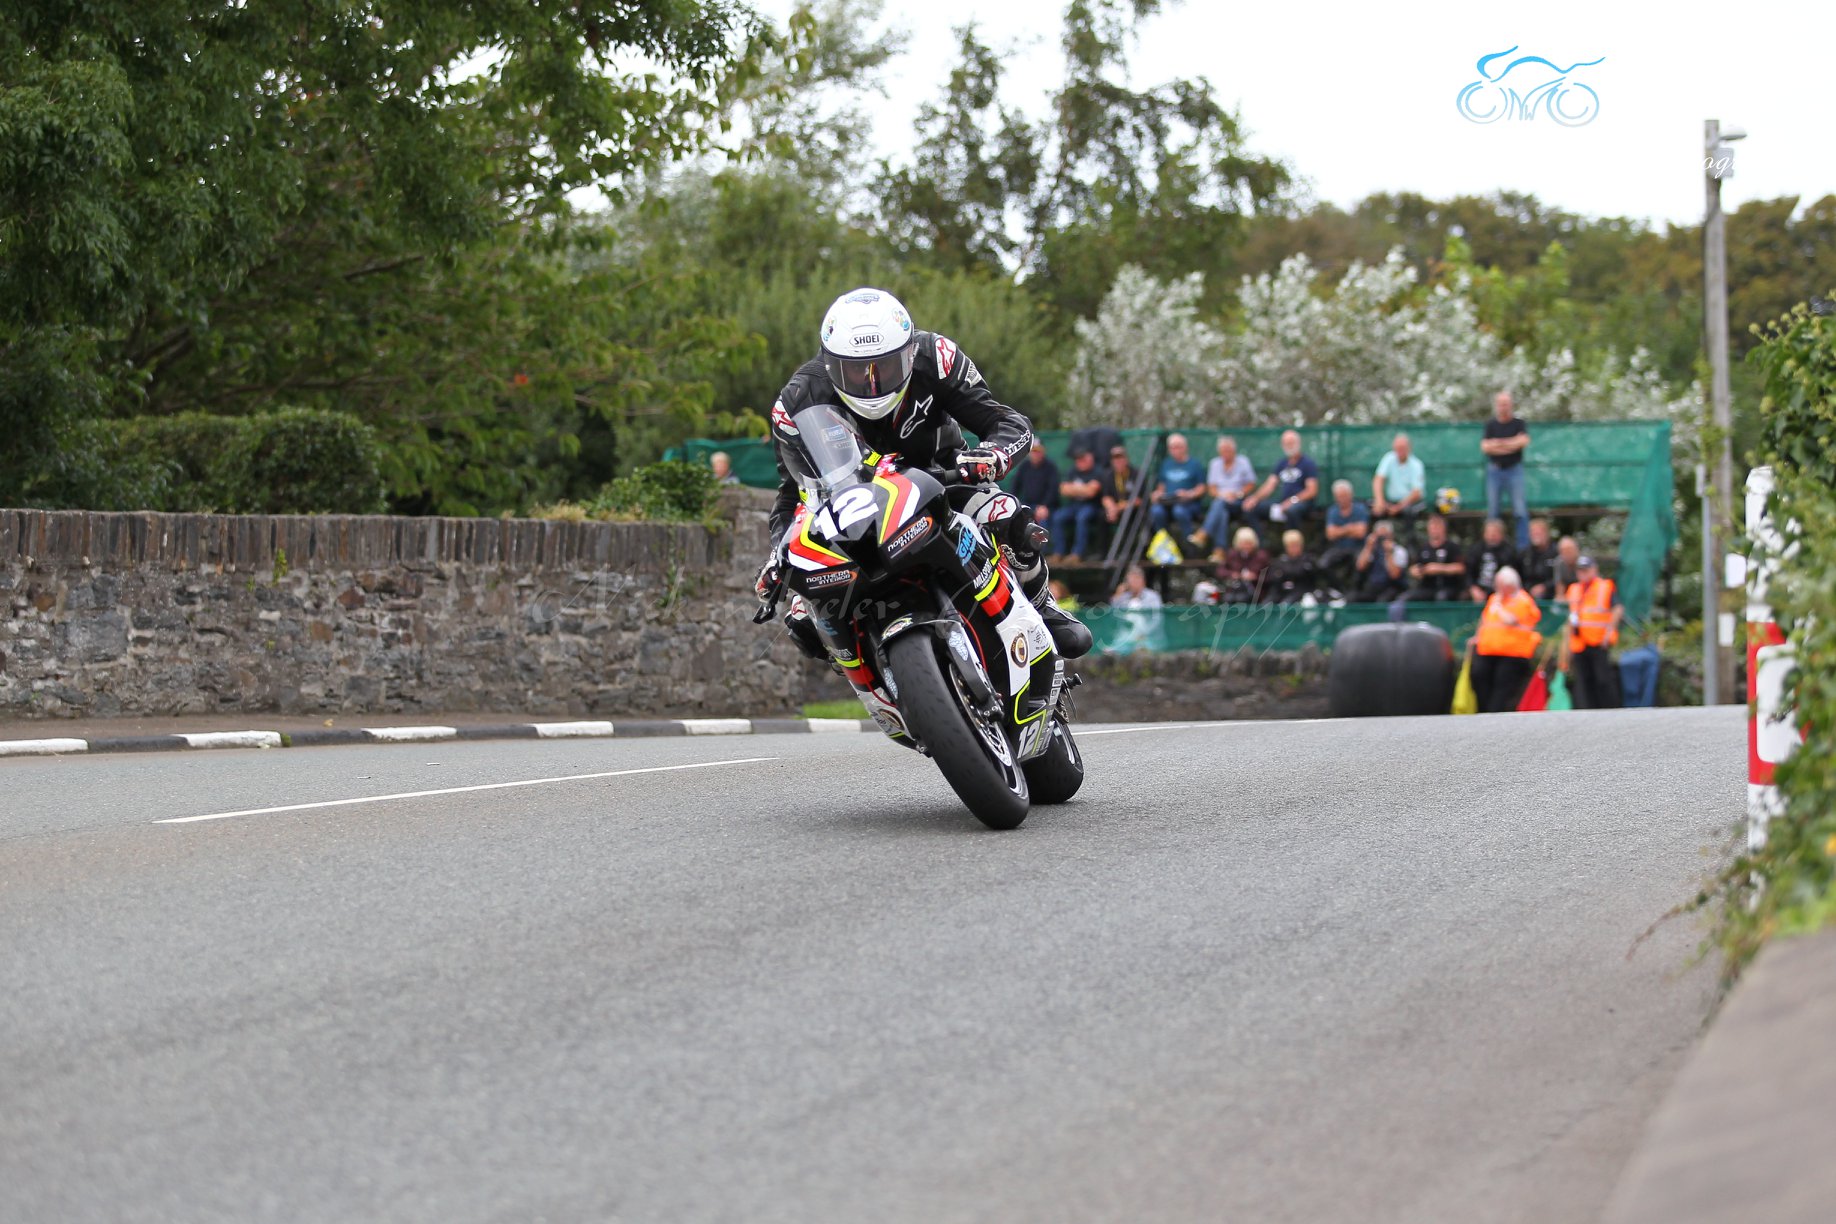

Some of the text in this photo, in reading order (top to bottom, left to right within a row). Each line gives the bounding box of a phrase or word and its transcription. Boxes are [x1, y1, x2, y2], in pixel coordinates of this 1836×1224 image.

[853, 334, 880, 345] SHOEI
[813, 487, 879, 541] 12
[1017, 721, 1039, 758] 12
